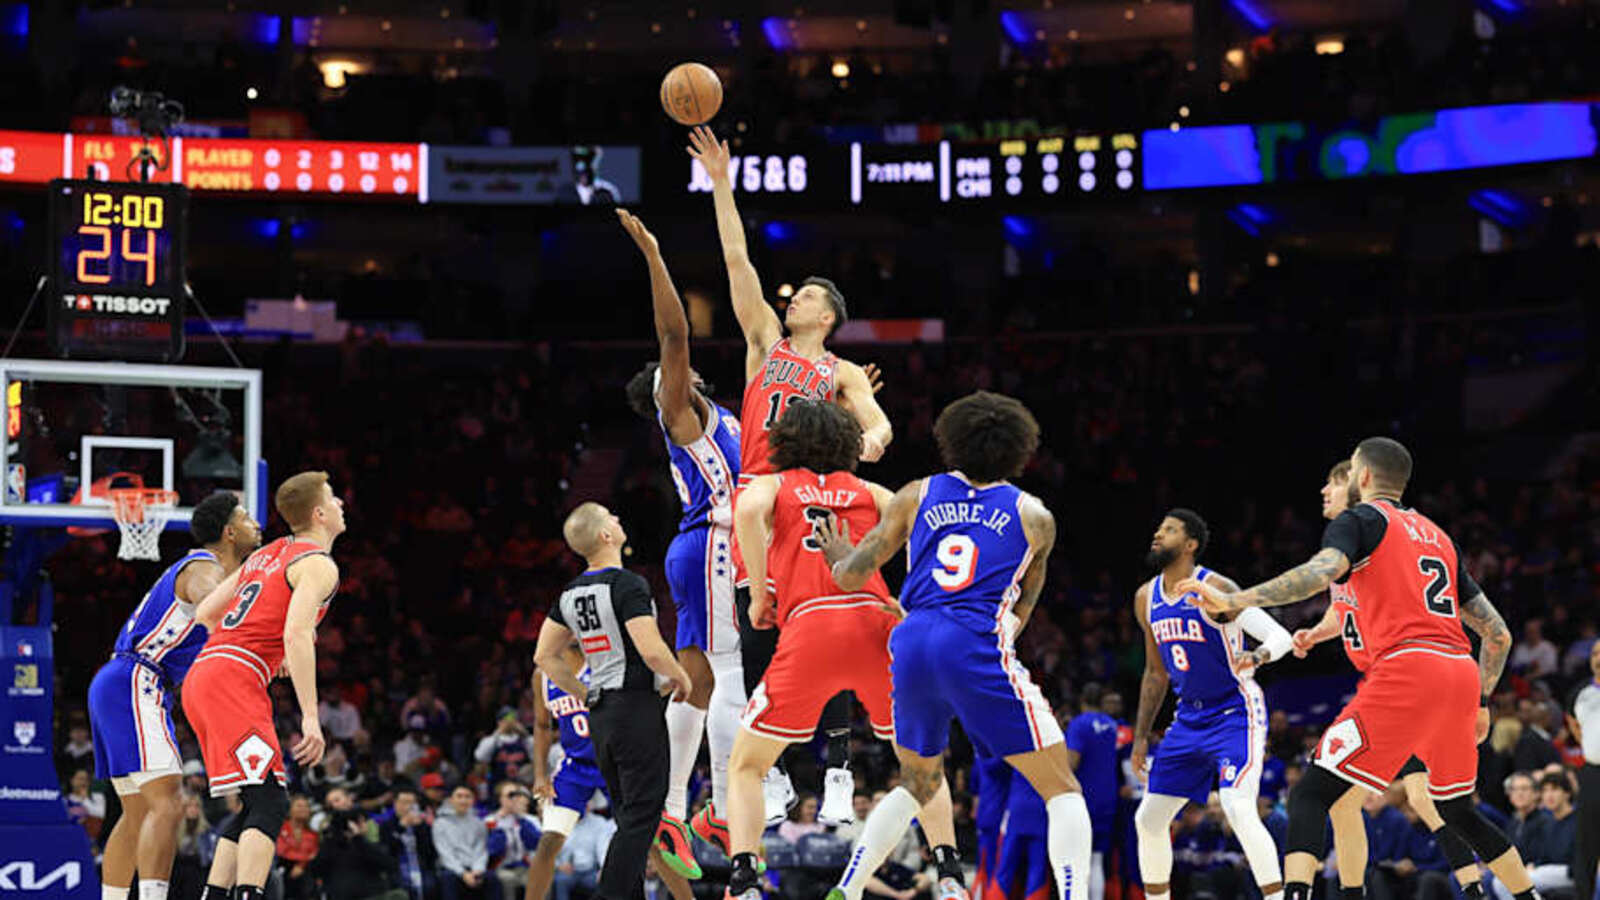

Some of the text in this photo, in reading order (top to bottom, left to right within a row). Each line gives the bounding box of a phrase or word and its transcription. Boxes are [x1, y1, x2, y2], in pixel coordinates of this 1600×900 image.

[84, 140, 115, 159] FLS
[186, 148, 412, 172] PLAYER 0 2 3 12 14
[1005, 155, 1022, 174] 0
[1042, 153, 1059, 173] 0
[1079, 151, 1096, 171] 0
[1116, 149, 1133, 169] 0
[187, 171, 408, 194] POINTS 0 0 0 0 0
[1005, 175, 1022, 195] 0
[1042, 173, 1059, 193] 0
[1079, 171, 1096, 191] 0
[1116, 169, 1133, 189] 0
[84, 192, 164, 229] 12:00
[77, 225, 156, 287] 24
[92, 295, 170, 315] TISSOT
[761, 358, 830, 401] BULLS
[923, 502, 1011, 536] OUBRE JR
[931, 533, 979, 593] 9
[1417, 555, 1457, 618] 2
[574, 594, 602, 632] 39
[1150, 617, 1208, 645] PHILA
[1171, 644, 1191, 672] 8
[571, 713, 591, 738] 0
